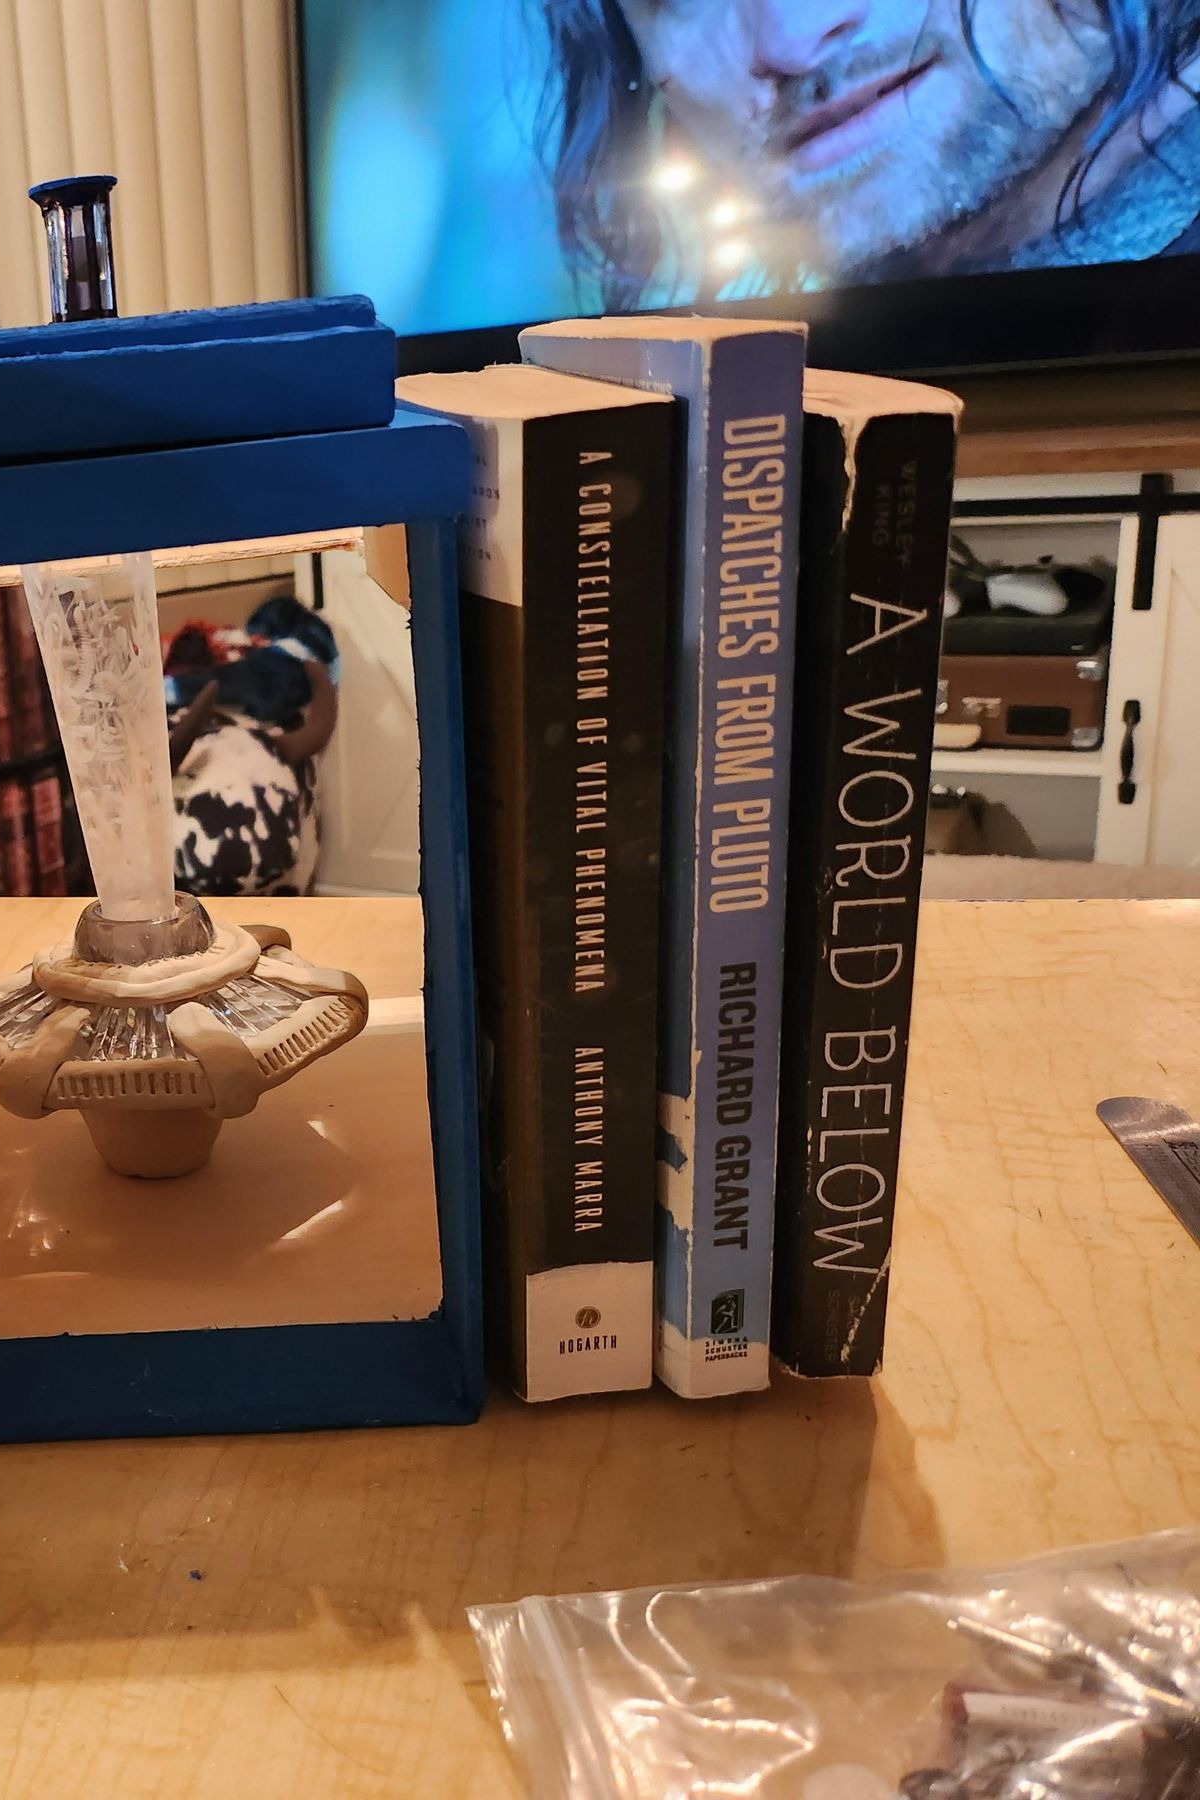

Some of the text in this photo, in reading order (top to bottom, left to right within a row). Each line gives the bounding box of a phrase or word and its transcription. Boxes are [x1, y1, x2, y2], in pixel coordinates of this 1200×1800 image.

[575, 451, 613, 992] A CONSTELLATION OF VITAL PHENOMENA
[709, 414, 786, 913] DISPATCHES FROM PLUTO
[813, 593, 928, 1274] A WORLD BELOW
[575, 1047, 604, 1232] ANTHONY MARRA
[713, 962, 757, 1250] RICHARD GRANT
[559, 1335, 617, 1355] HOGARTH
[705, 1344, 748, 1355] SCHUSTER
